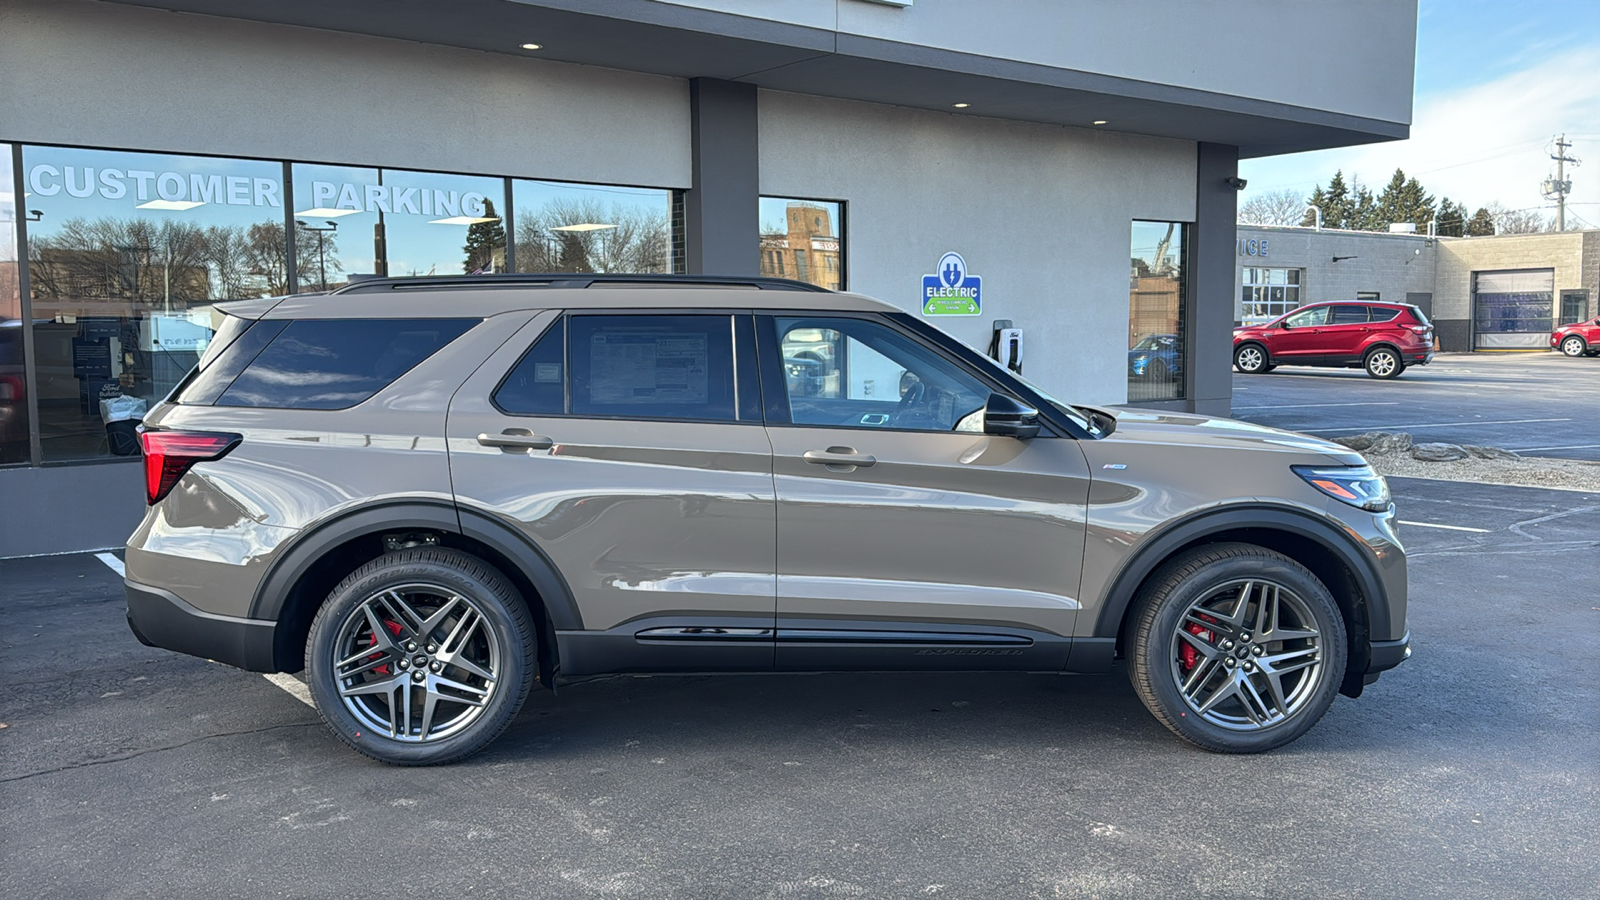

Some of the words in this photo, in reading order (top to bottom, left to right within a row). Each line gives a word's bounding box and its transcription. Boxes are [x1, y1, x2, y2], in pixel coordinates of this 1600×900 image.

[28, 163, 281, 207] CUSTOMER
[312, 181, 486, 218] PARKING
[1236, 239, 1268, 256] ICE
[926, 286, 978, 298] ELECTRIC
[101, 383, 120, 392] Ford
